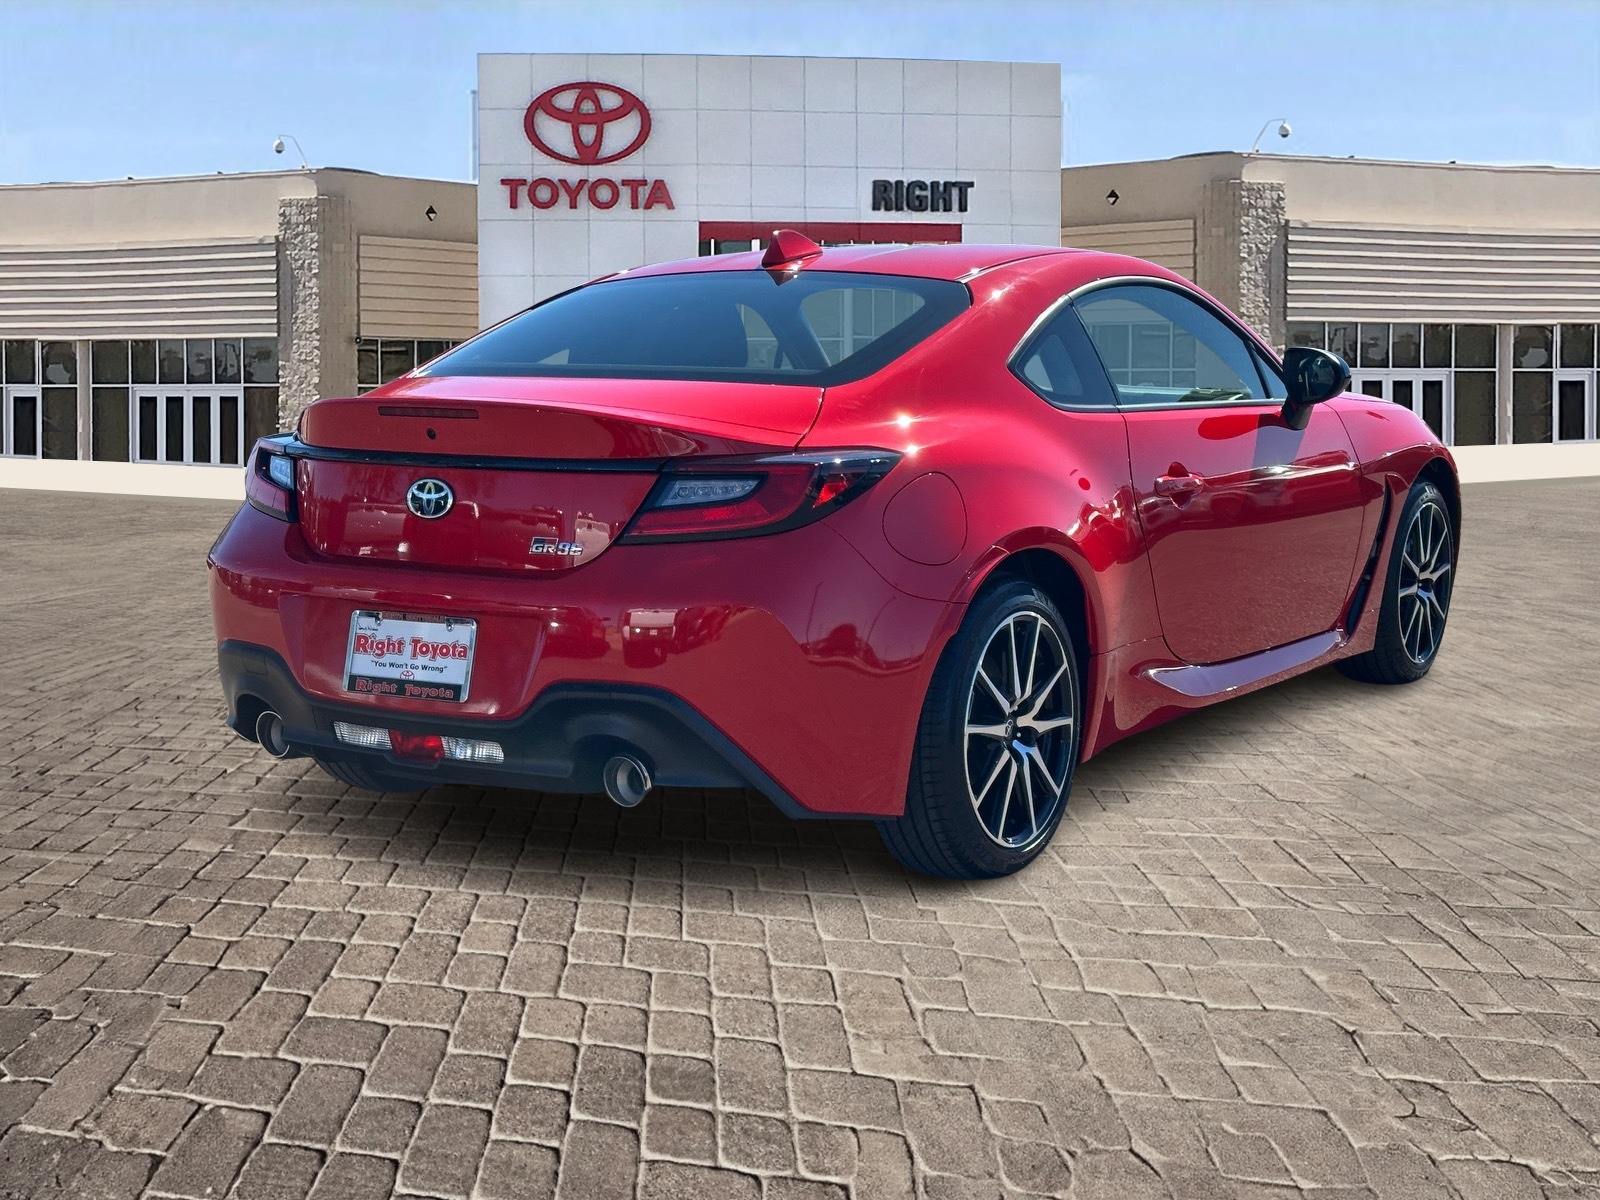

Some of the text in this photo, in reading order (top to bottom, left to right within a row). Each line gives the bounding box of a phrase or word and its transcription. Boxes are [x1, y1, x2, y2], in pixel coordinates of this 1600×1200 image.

[500, 178, 675, 210] TOYOTA
[871, 179, 975, 212] RIGHT
[354, 633, 469, 661] Right Toyota
[355, 679, 454, 698] Right Toyota
